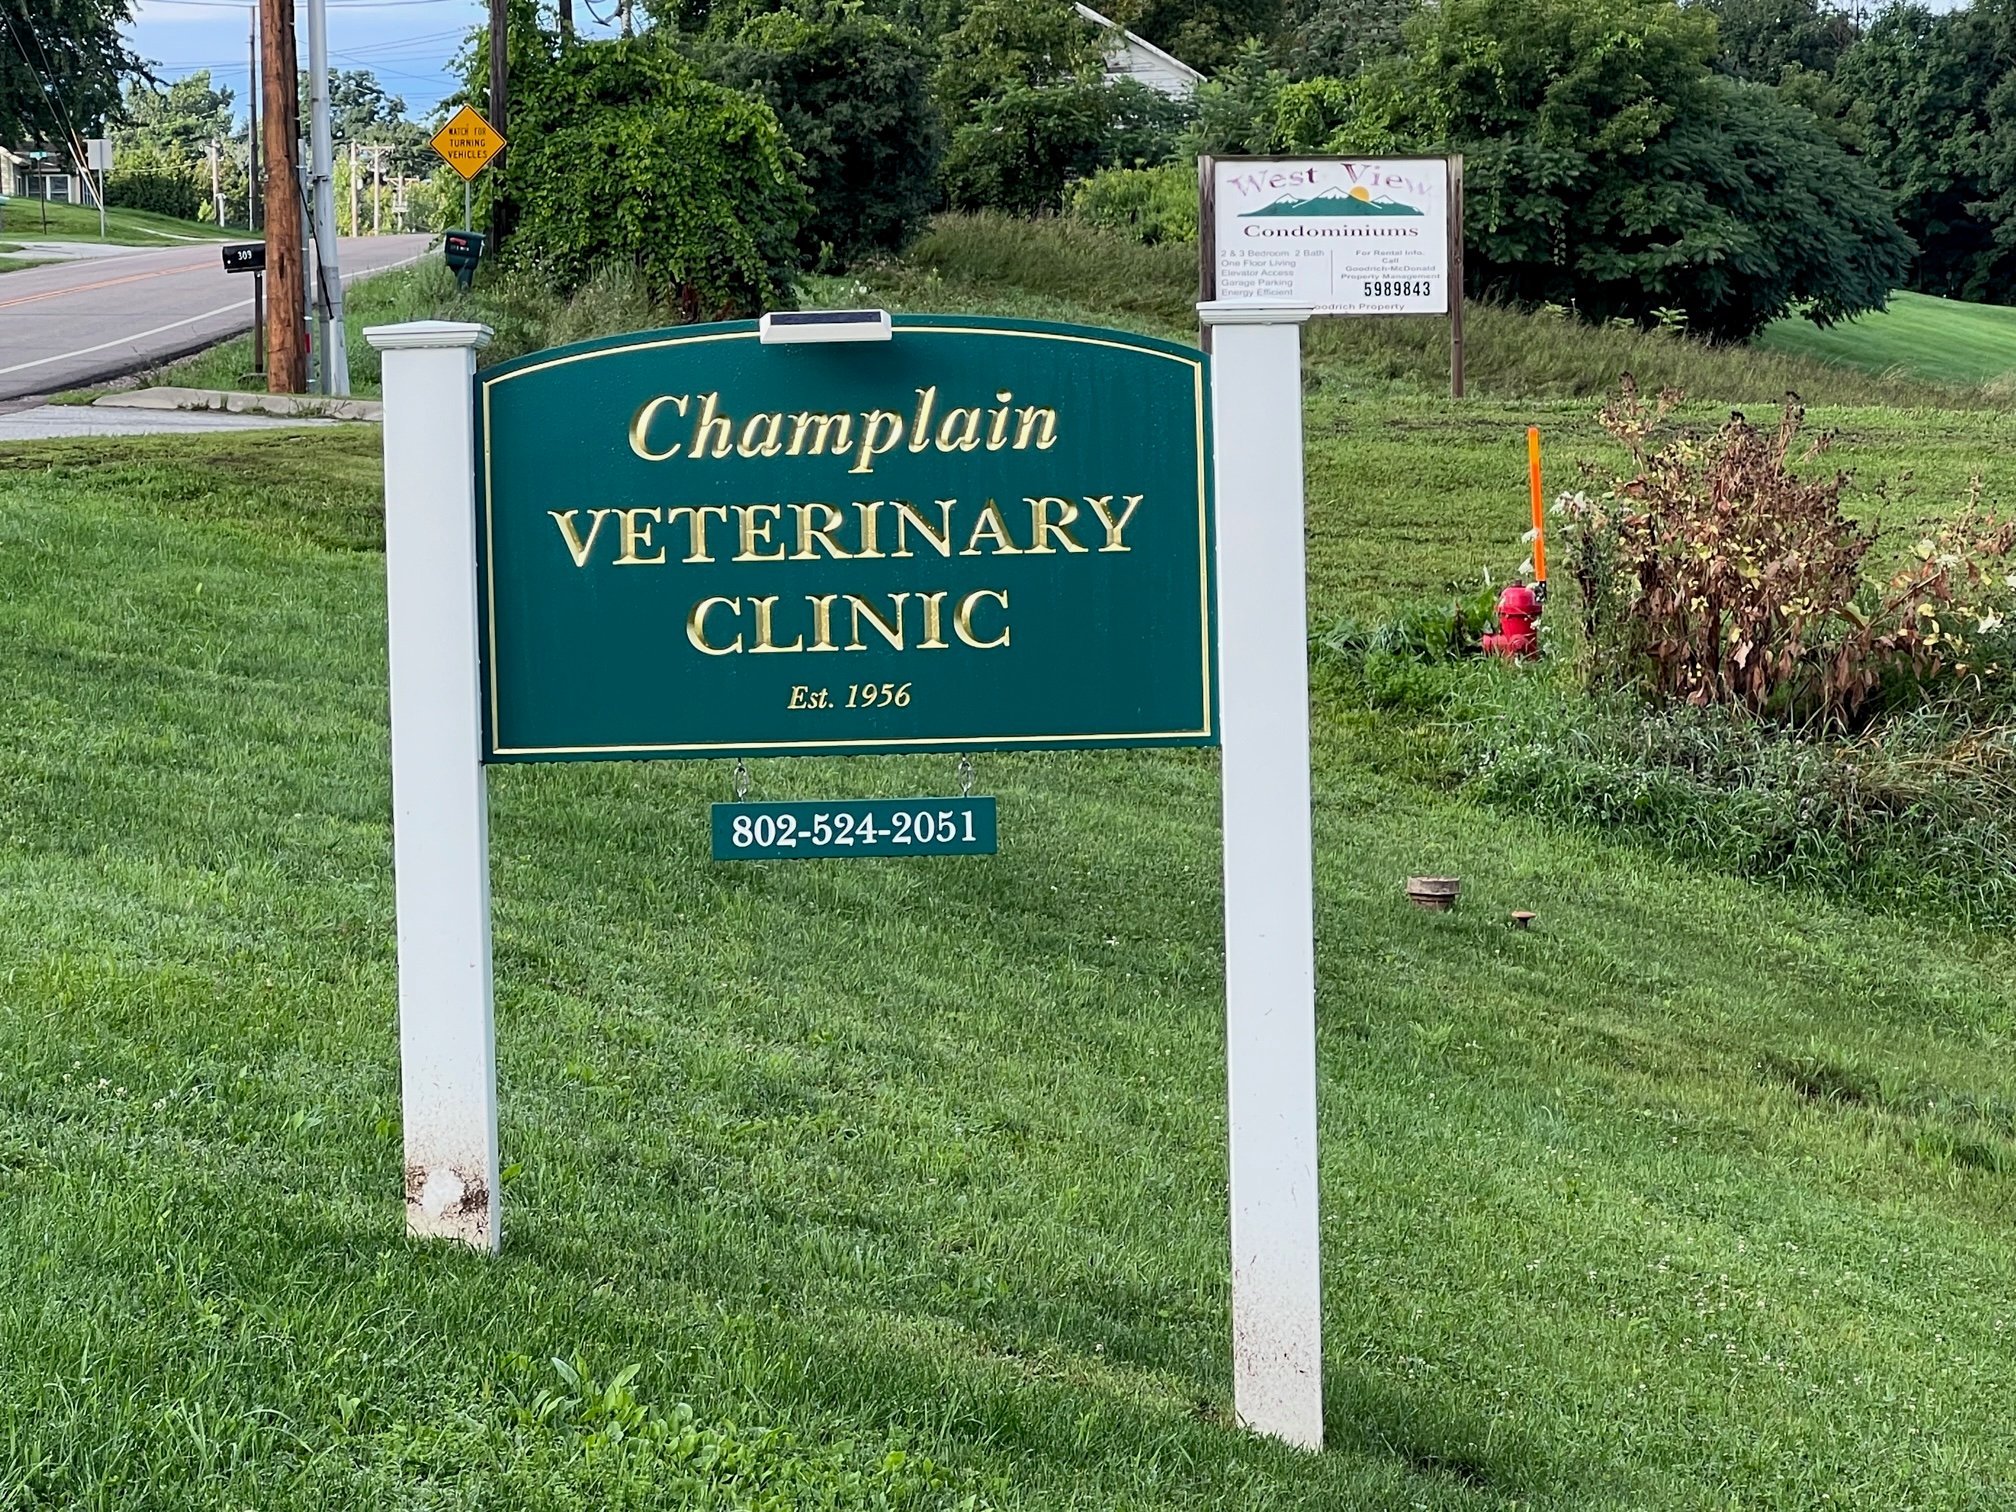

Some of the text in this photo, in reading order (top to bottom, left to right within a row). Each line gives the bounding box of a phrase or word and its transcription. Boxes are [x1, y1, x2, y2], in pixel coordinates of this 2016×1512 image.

[448, 128, 486, 136] WATCH FOR
[450, 139, 486, 147] TURNING
[448, 150, 488, 159] VEHICLES
[1227, 163, 1433, 198] West View
[1243, 225, 1419, 238] Condominiums
[237, 249, 252, 260] 309
[1220, 249, 1325, 257] 2 & 3 Bedroom 2 Bath
[1221, 259, 1297, 268] One Floor Living
[1221, 269, 1294, 277] Elevator Access
[1221, 279, 1293, 287] Garage Parking
[1221, 288, 1293, 297] Energy Efficient
[1364, 281, 1431, 296] 5989843
[1359, 303, 1405, 311] Property
[629, 386, 1060, 474] Champlain
[547, 495, 1144, 568] VETERINARY
[686, 590, 1012, 656] CLINIC
[787, 682, 912, 711] Est. 1956
[731, 809, 978, 850] 802-524-2051
